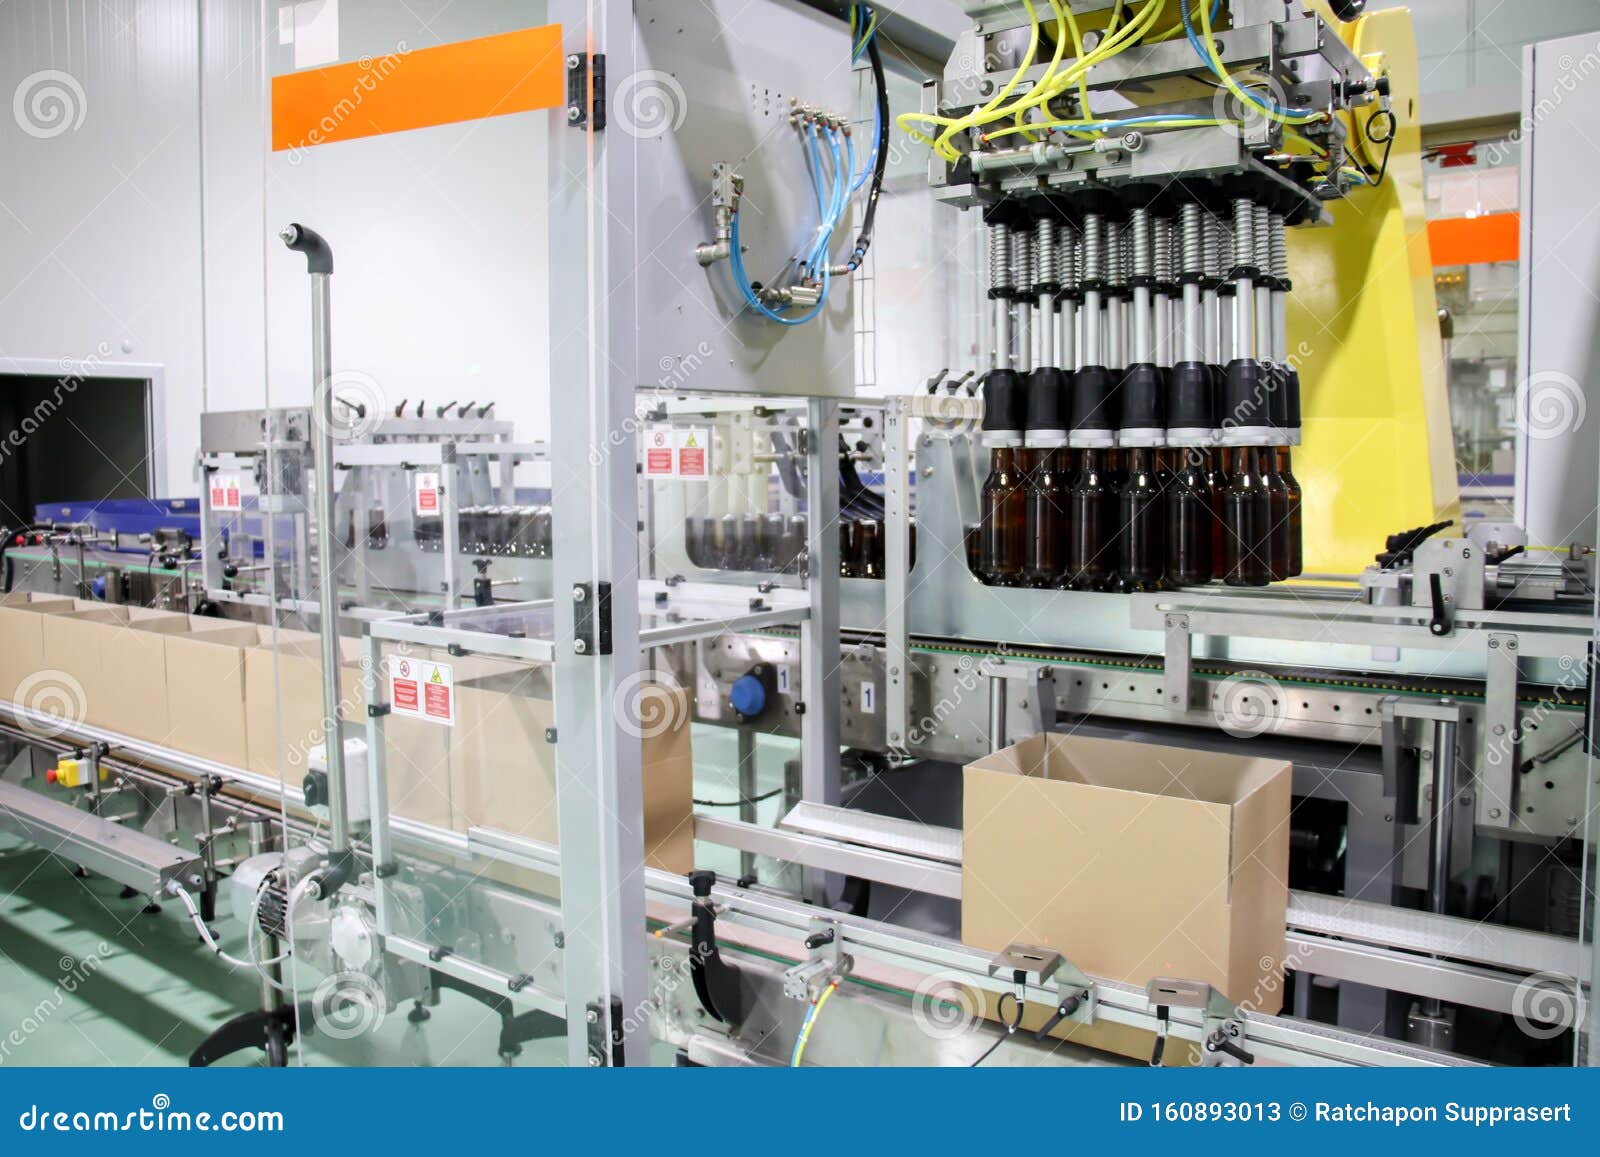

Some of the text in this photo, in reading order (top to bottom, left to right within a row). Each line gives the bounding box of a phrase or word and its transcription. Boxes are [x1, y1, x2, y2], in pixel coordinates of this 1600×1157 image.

[1463, 548, 1471, 559] 6
[781, 669, 787, 689] 1
[865, 688, 871, 708] 1
[1081, 989, 1089, 1001] 4
[1230, 1024, 1239, 1037] 5
